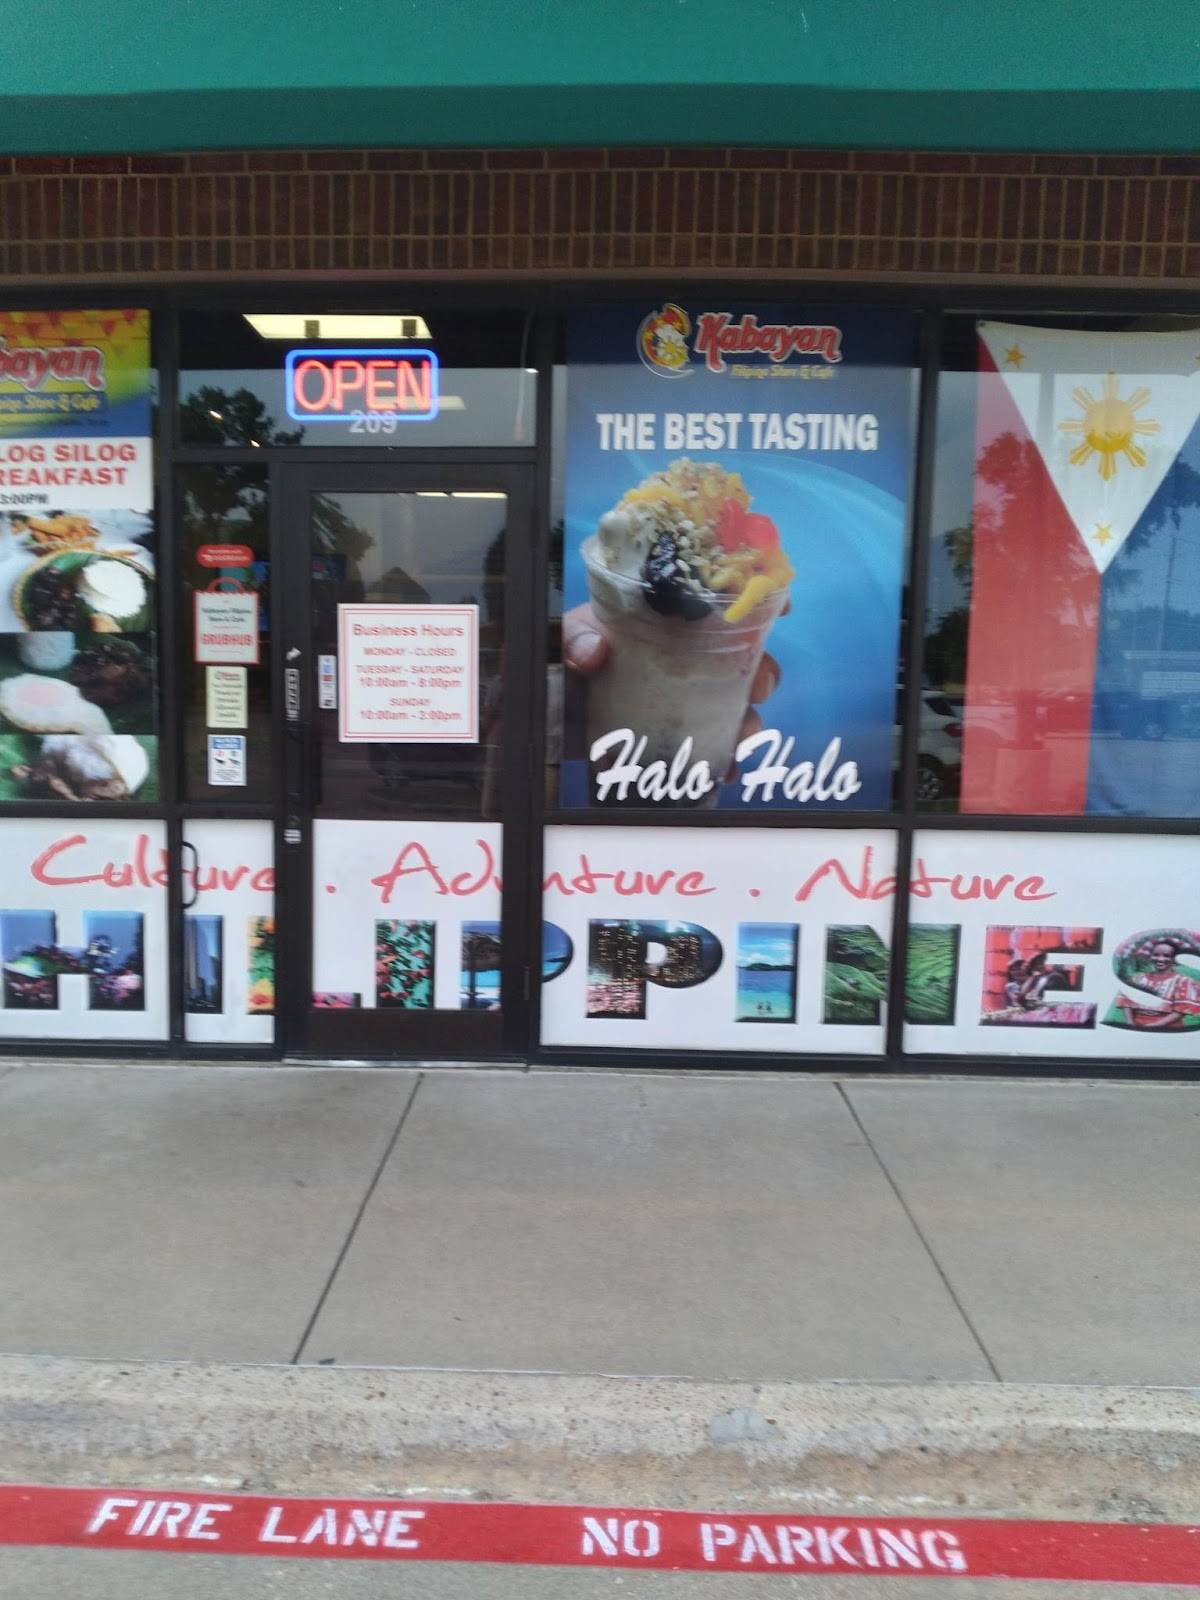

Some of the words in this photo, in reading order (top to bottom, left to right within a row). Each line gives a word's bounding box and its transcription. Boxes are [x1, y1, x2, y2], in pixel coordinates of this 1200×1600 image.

[695, 312, 842, 373] Kabayan
[294, 360, 432, 411] OPEN
[350, 409, 397, 434] 209
[596, 413, 656, 451] THE
[664, 413, 742, 451] BEST
[748, 413, 879, 451] TASTING
[54, 443, 137, 463] SILOG
[352, 623, 417, 637] Business
[421, 624, 464, 637] Hours
[363, 647, 405, 656] MONDAY
[414, 647, 456, 656] CLOSED
[355, 664, 402, 674] TUESDAY
[410, 664, 464, 674] SATURDAY
[389, 697, 431, 706] SUNDAY
[590, 728, 714, 801] Halo
[736, 729, 862, 802] Halo
[370, 839, 717, 903] Adnture
[794, 845, 1057, 903] Nature
[84, 1498, 233, 1540] FIRE
[258, 1506, 426, 1549] LANE
[581, 1517, 660, 1558] NO
[700, 1523, 969, 1572] PARKING
